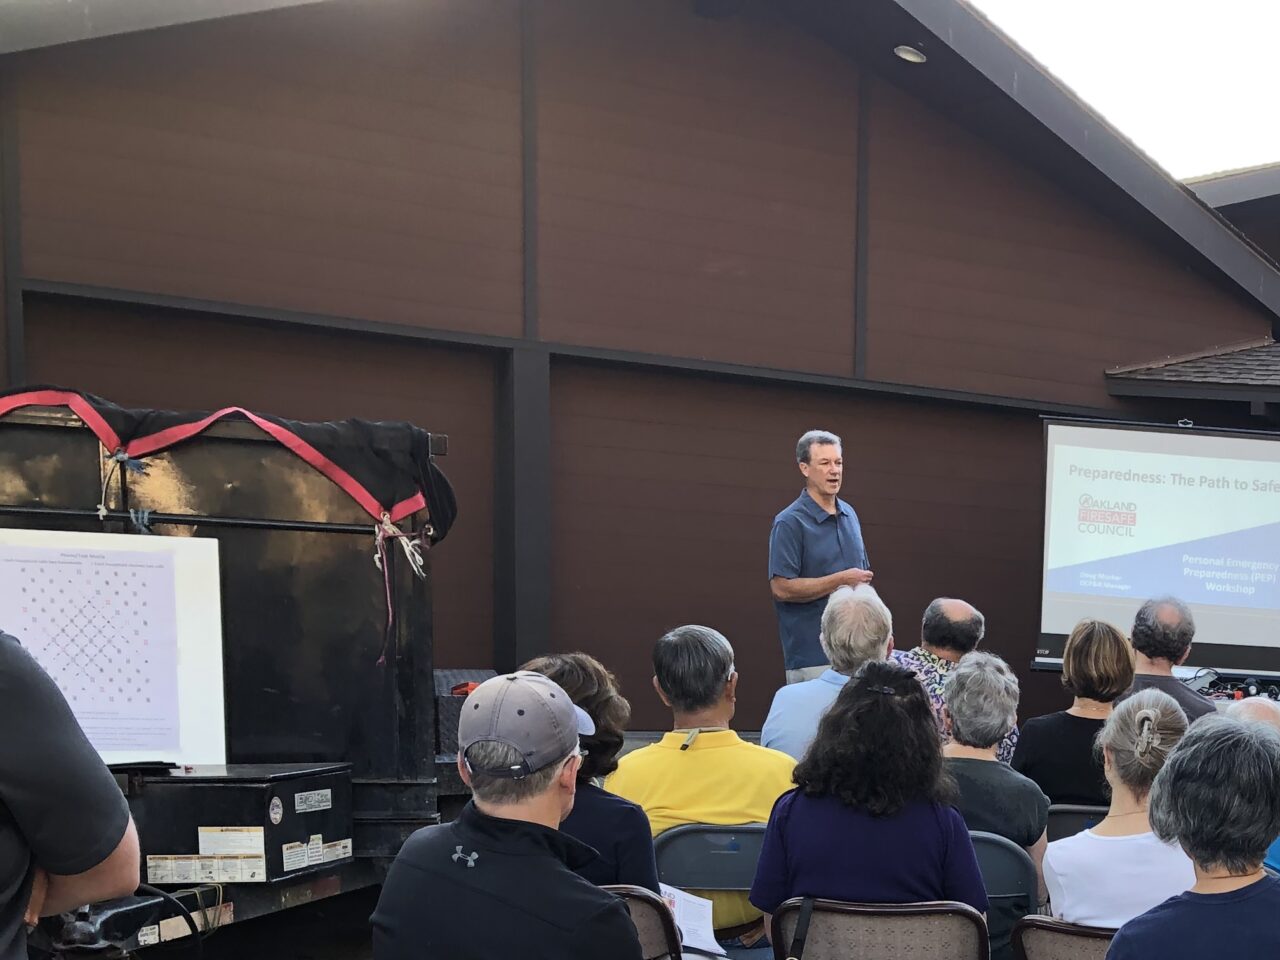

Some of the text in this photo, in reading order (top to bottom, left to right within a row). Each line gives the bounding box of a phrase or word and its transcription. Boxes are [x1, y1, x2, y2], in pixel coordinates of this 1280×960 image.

[1069, 464, 1166, 484] Preparedness:
[1170, 473, 1195, 487] The
[1199, 476, 1229, 490] Path
[1234, 479, 1248, 491] to
[1079, 493, 1136, 511] OAKLAND
[1079, 510, 1136, 526] FIRESAFE
[1078, 523, 1135, 537] COUNCIL
[1182, 555, 1280, 571] Personal Emergency
[1183, 567, 1277, 584] Preparedness (PEP)
[1205, 582, 1255, 595] Workshop
